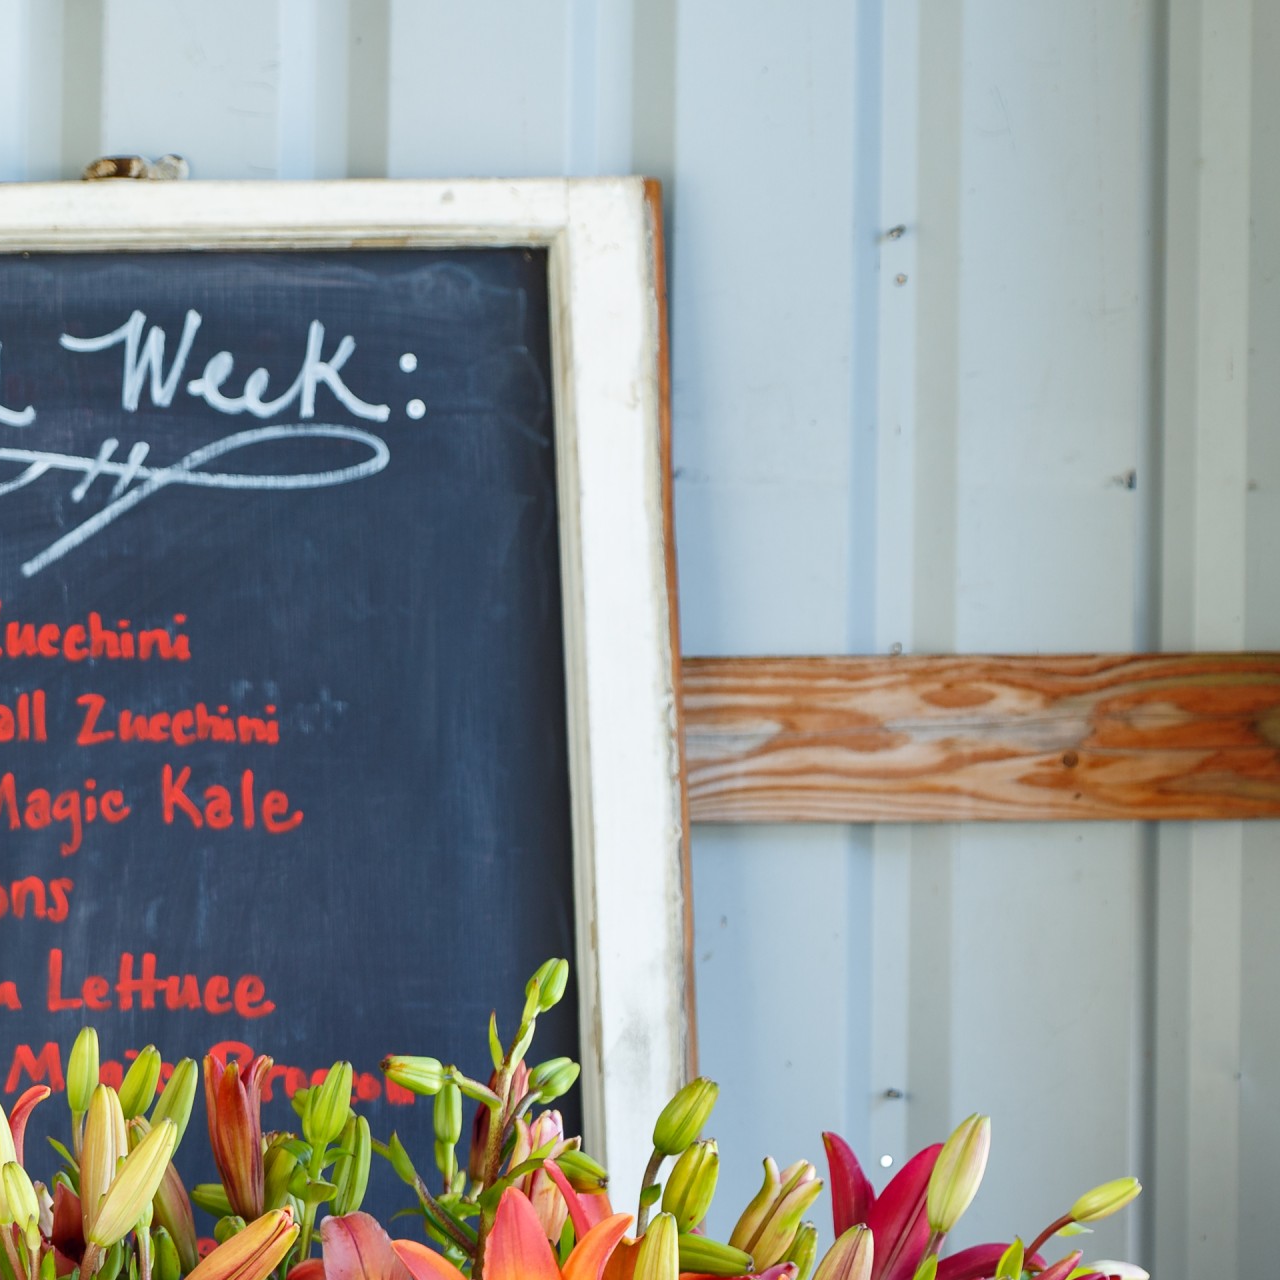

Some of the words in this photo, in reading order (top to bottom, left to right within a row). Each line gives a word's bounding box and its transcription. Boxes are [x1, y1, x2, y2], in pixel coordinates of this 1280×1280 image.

[77, 694, 279, 745] Zucchini
[162, 764, 303, 833] Kale
[48, 948, 276, 1018] Lettuce
